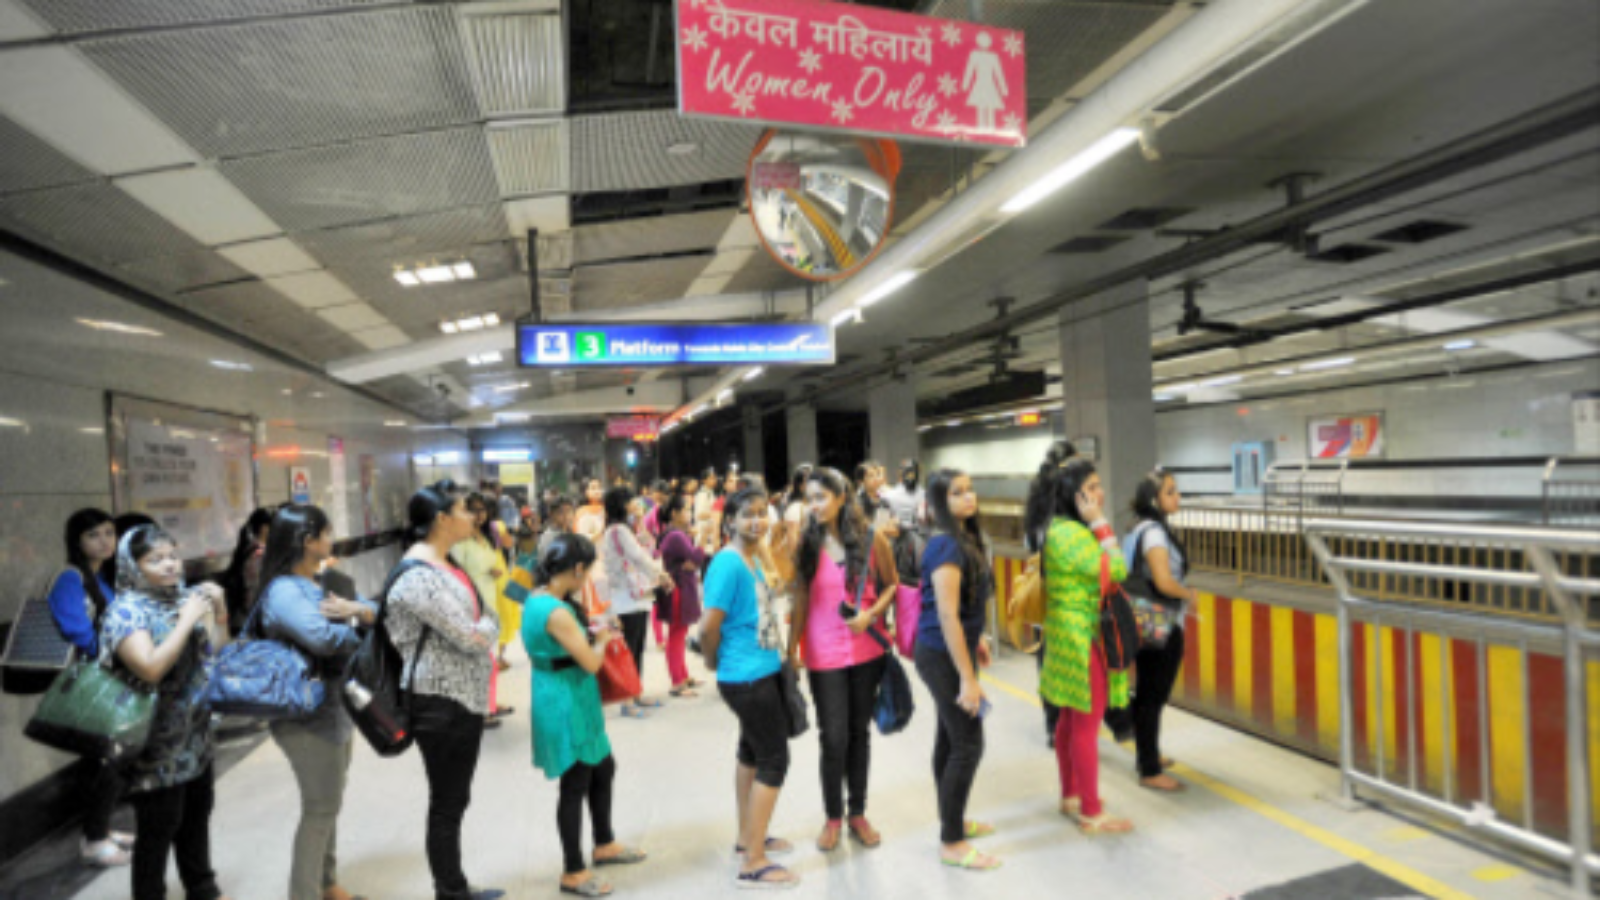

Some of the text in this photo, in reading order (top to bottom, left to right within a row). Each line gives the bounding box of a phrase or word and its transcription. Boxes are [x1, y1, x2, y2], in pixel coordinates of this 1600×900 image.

[703, 0, 798, 48] केवल
[705, 48, 938, 129] Women Only
[584, 335, 599, 356] 3
